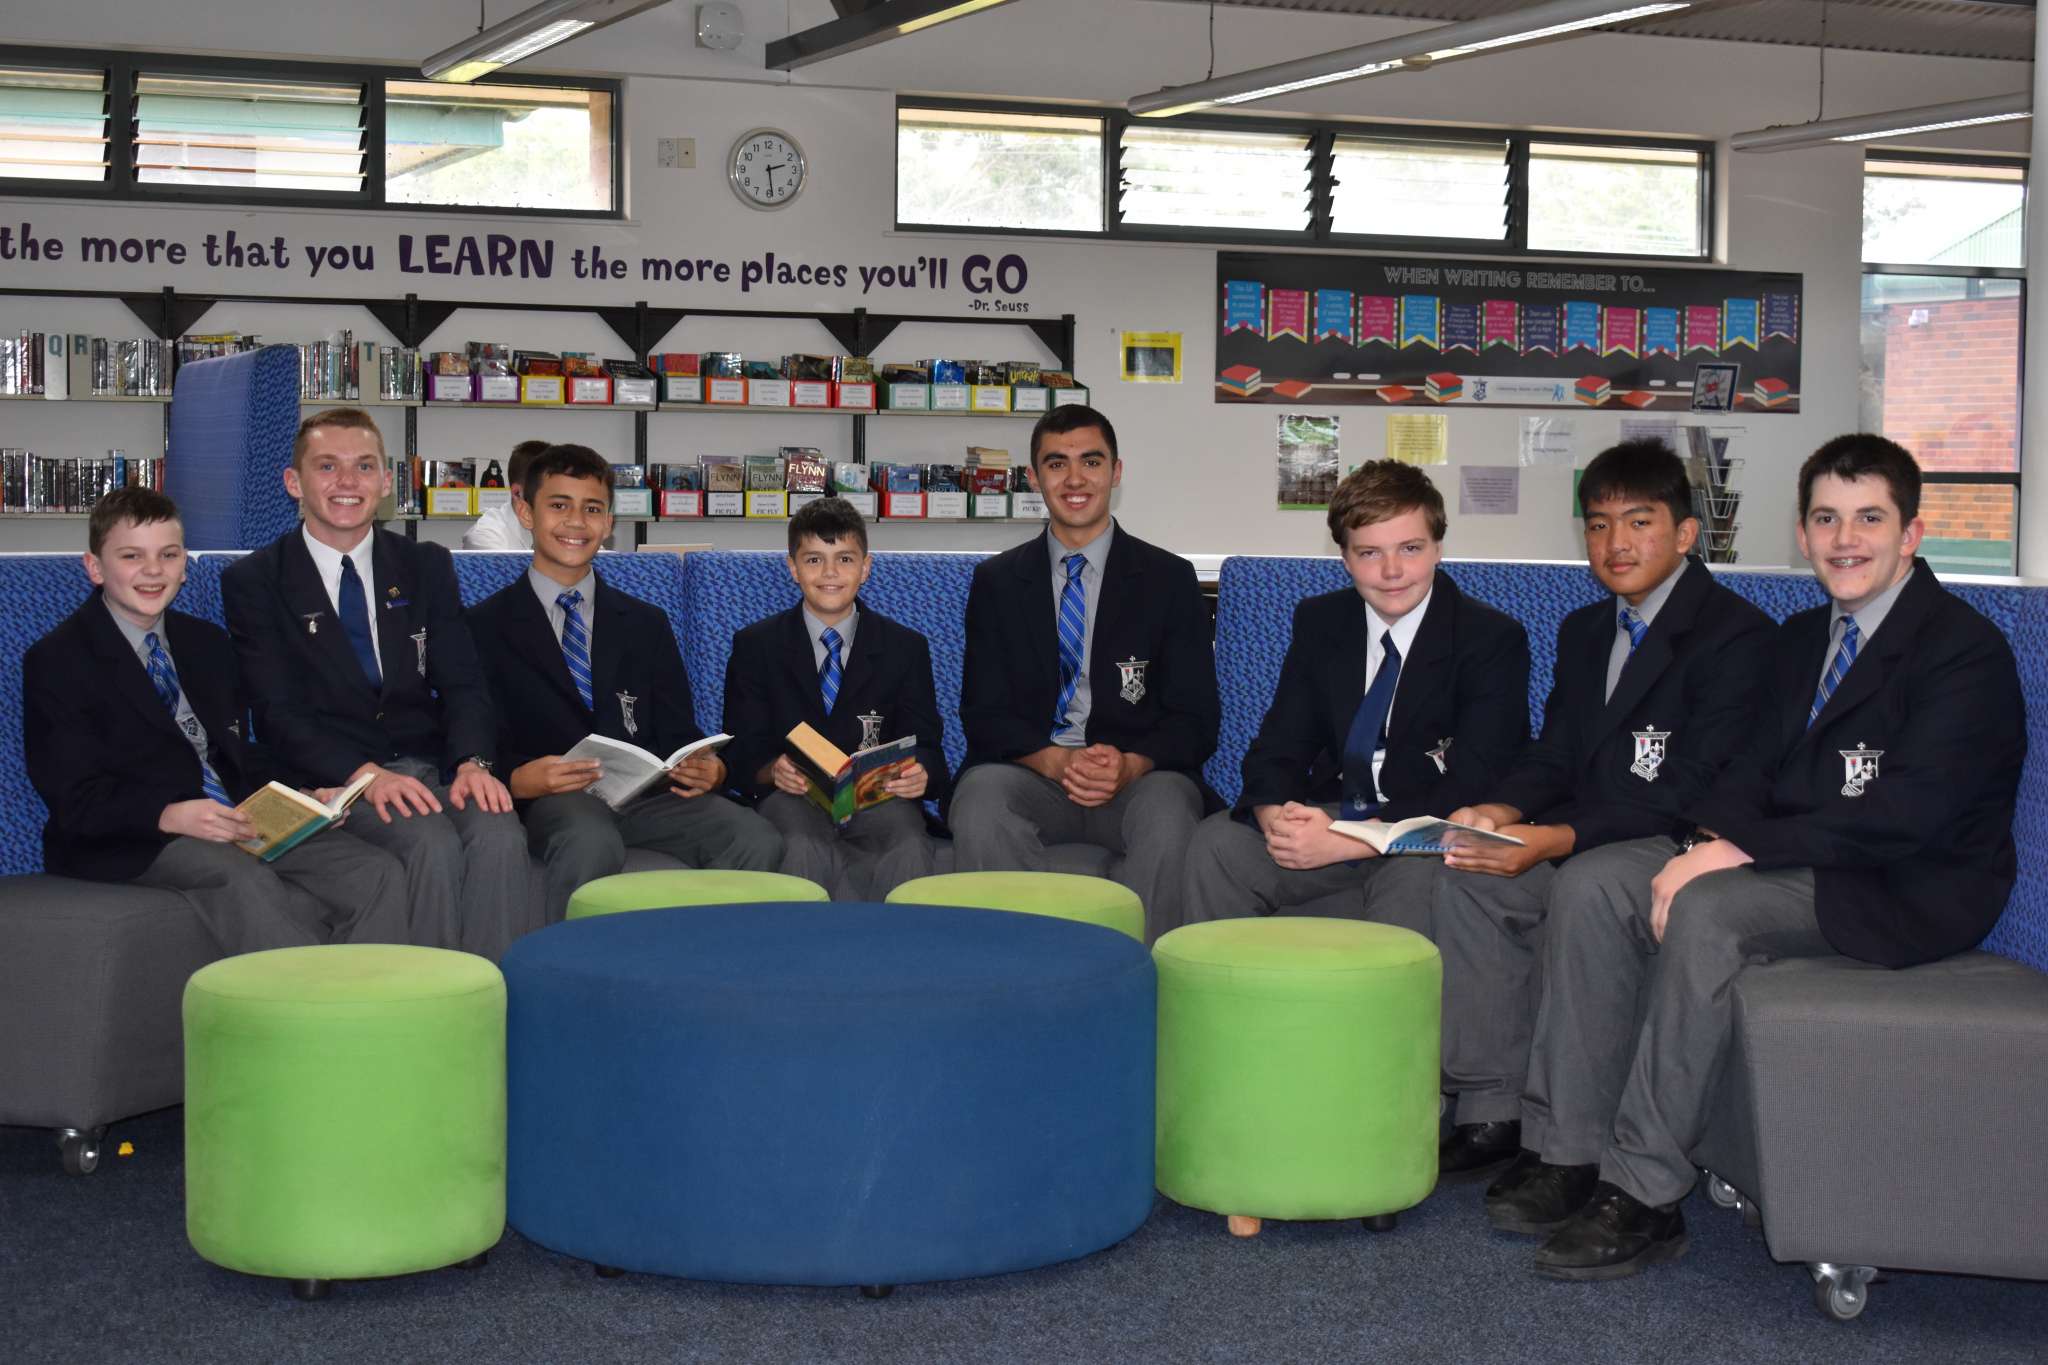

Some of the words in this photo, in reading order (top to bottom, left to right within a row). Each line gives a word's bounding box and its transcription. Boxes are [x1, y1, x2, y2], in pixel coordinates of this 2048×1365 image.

[753, 144, 760, 152] 11
[764, 140, 773, 149] 12
[744, 153, 752, 161] 10
[787, 152, 793, 161] 2
[745, 177, 750, 186] 8
[753, 186, 760, 196] 7
[778, 187, 784, 196] 5
[0, 222, 64, 262] the
[80, 237, 187, 265] more
[202, 230, 290, 269] that
[304, 245, 374, 278] you
[398, 233, 554, 279] LEARN
[570, 245, 628, 281] the
[642, 257, 731, 283] more
[741, 252, 848, 293] places
[858, 255, 948, 295] you'll
[961, 253, 1028, 295] GO
[1384, 266, 1440, 286] WHEN
[1444, 268, 1521, 289] WRITING
[1526, 271, 1616, 292] REMEMBER
[994, 299, 1029, 313] Seuss
[48, 334, 63, 358] Q
[74, 334, 88, 355] R
[363, 341, 375, 361] T
[788, 463, 826, 477] FLYNN
[710, 472, 741, 482] FLYNN
[752, 472, 783, 482] FLYNN
